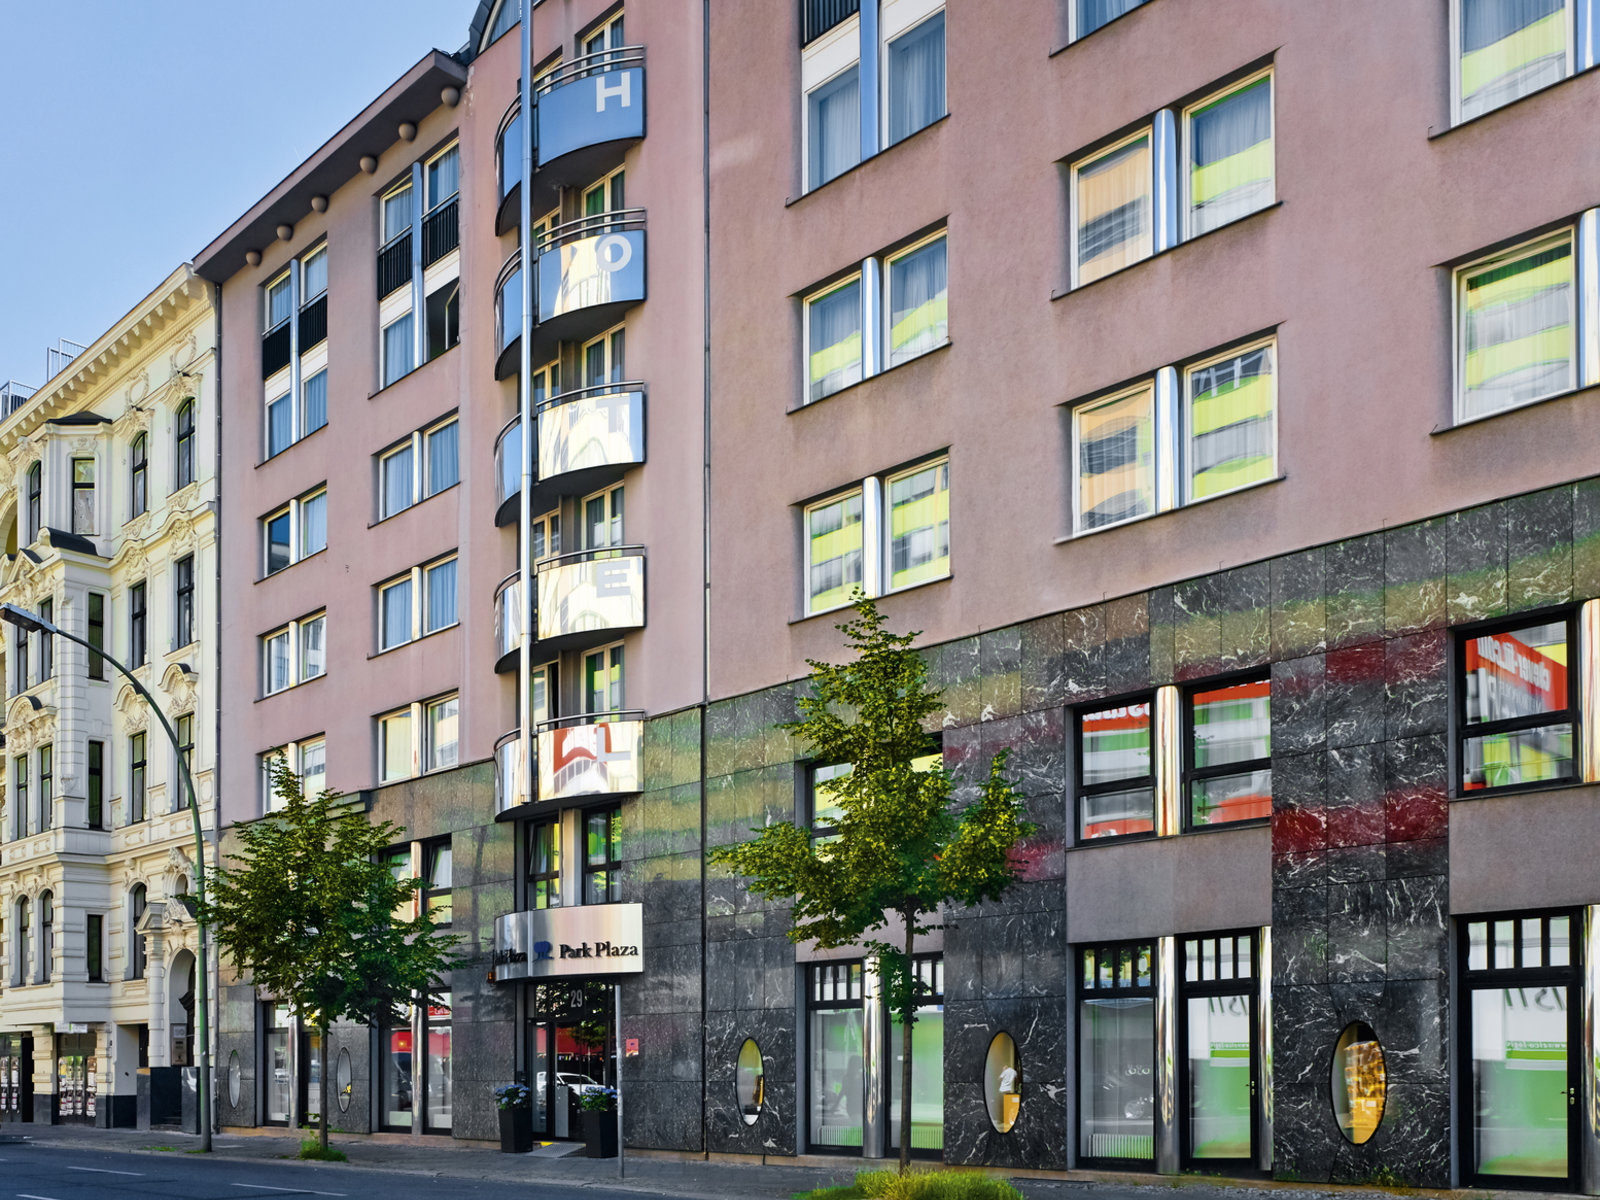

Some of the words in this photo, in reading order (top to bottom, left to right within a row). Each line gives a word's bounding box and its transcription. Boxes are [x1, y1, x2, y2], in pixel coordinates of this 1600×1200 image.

[559, 942, 592, 959] Park
[595, 941, 639, 957] Plaza
[570, 989, 583, 1008] 29
